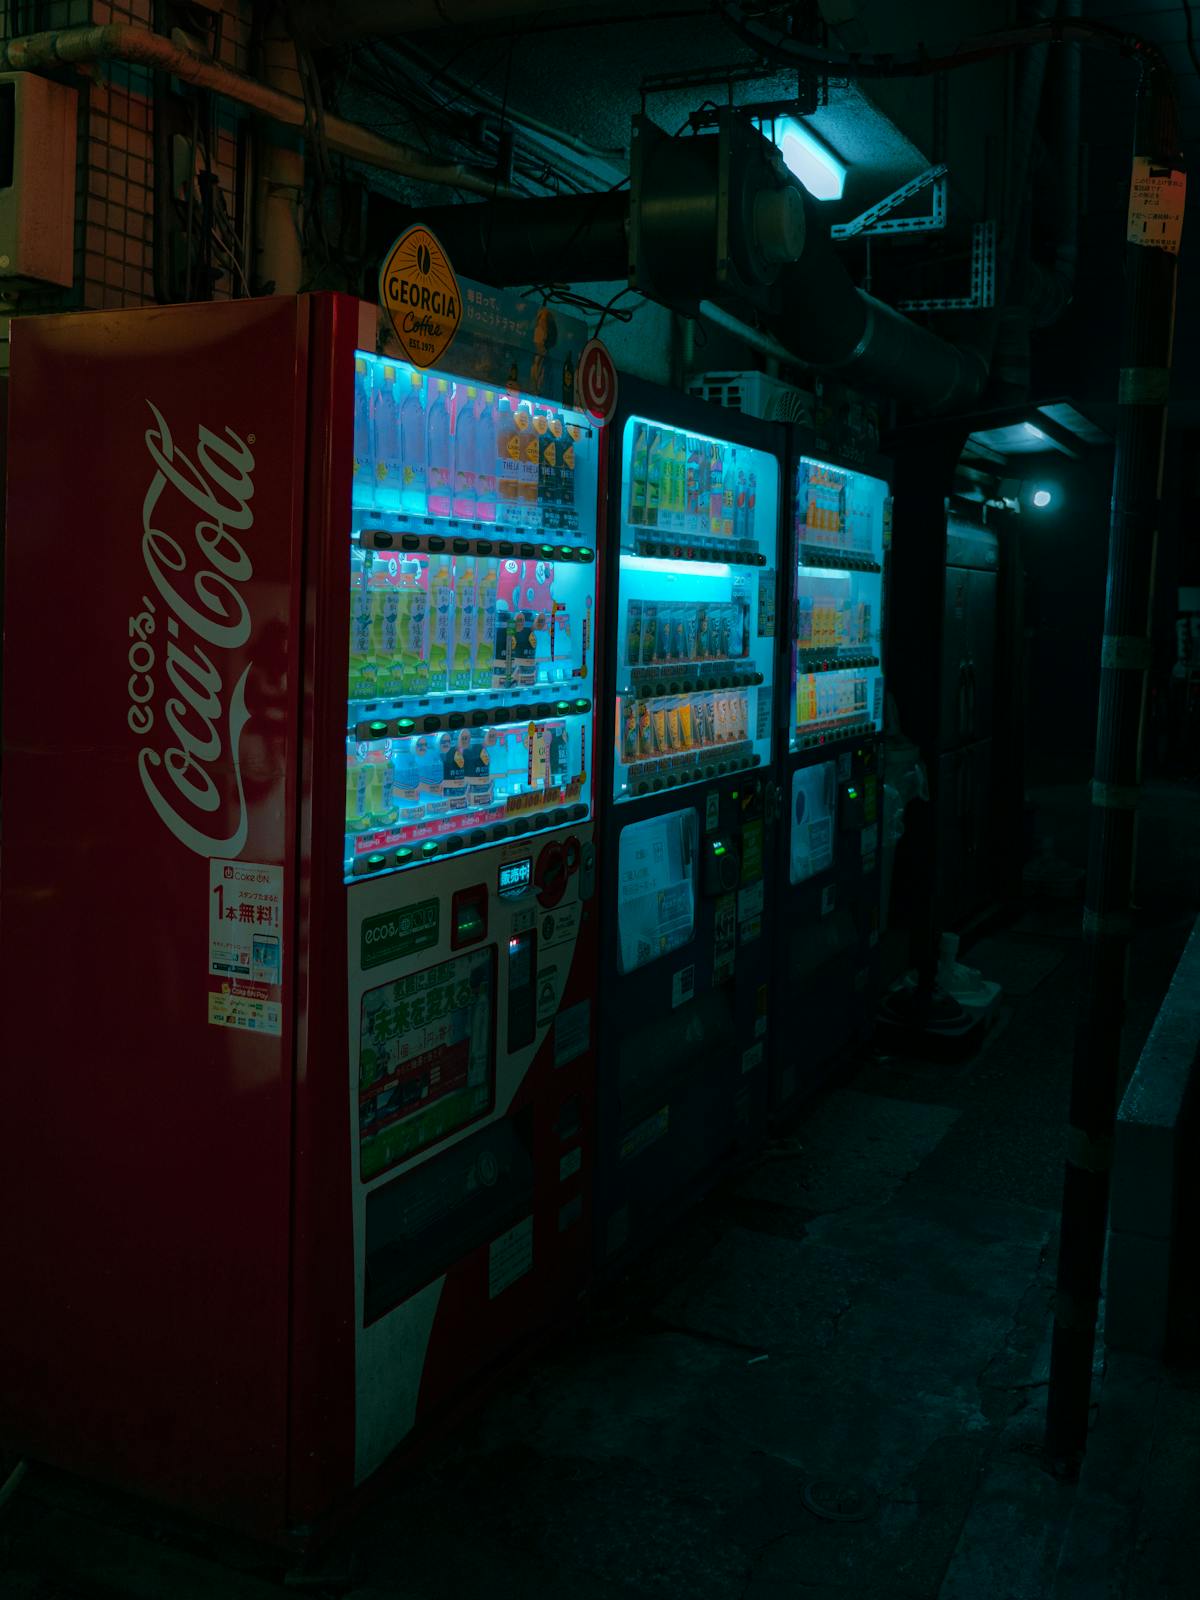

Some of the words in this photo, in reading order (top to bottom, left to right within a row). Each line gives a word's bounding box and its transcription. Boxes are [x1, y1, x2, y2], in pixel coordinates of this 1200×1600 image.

[388, 277, 457, 319] GEORGIA
[402, 311, 444, 338] Coffee
[138, 398, 255, 860] Coca-Cola
[235, 871, 256, 882] Coke
[257, 873, 270, 884] ON
[501, 862, 531, 886] 販売中
[257, 991, 269, 1001] Pay
[374, 977, 473, 1044] 未来を変える
